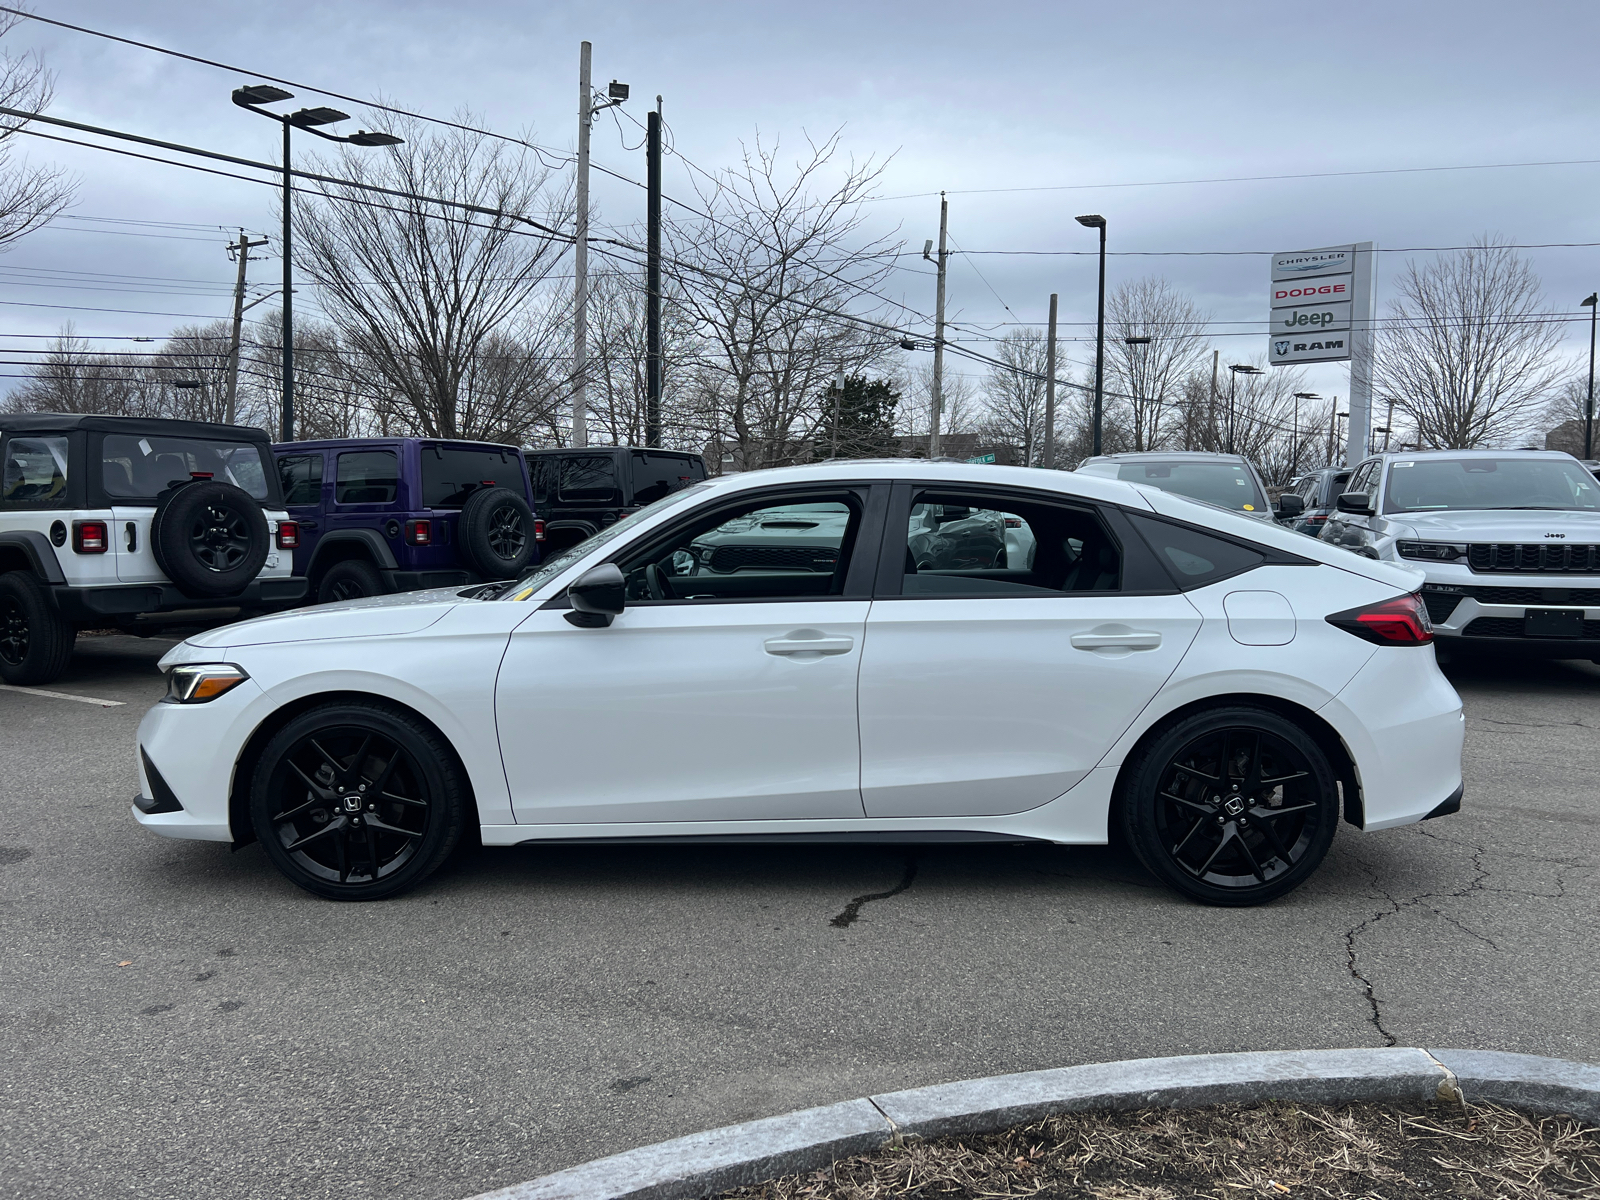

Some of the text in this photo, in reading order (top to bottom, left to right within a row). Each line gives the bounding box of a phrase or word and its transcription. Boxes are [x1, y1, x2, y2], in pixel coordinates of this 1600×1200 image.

[1278, 253, 1345, 266] CHRYSLER
[1275, 284, 1346, 299] DODGE
[1284, 311, 1334, 327] Jeep
[1293, 340, 1344, 352] RAM
